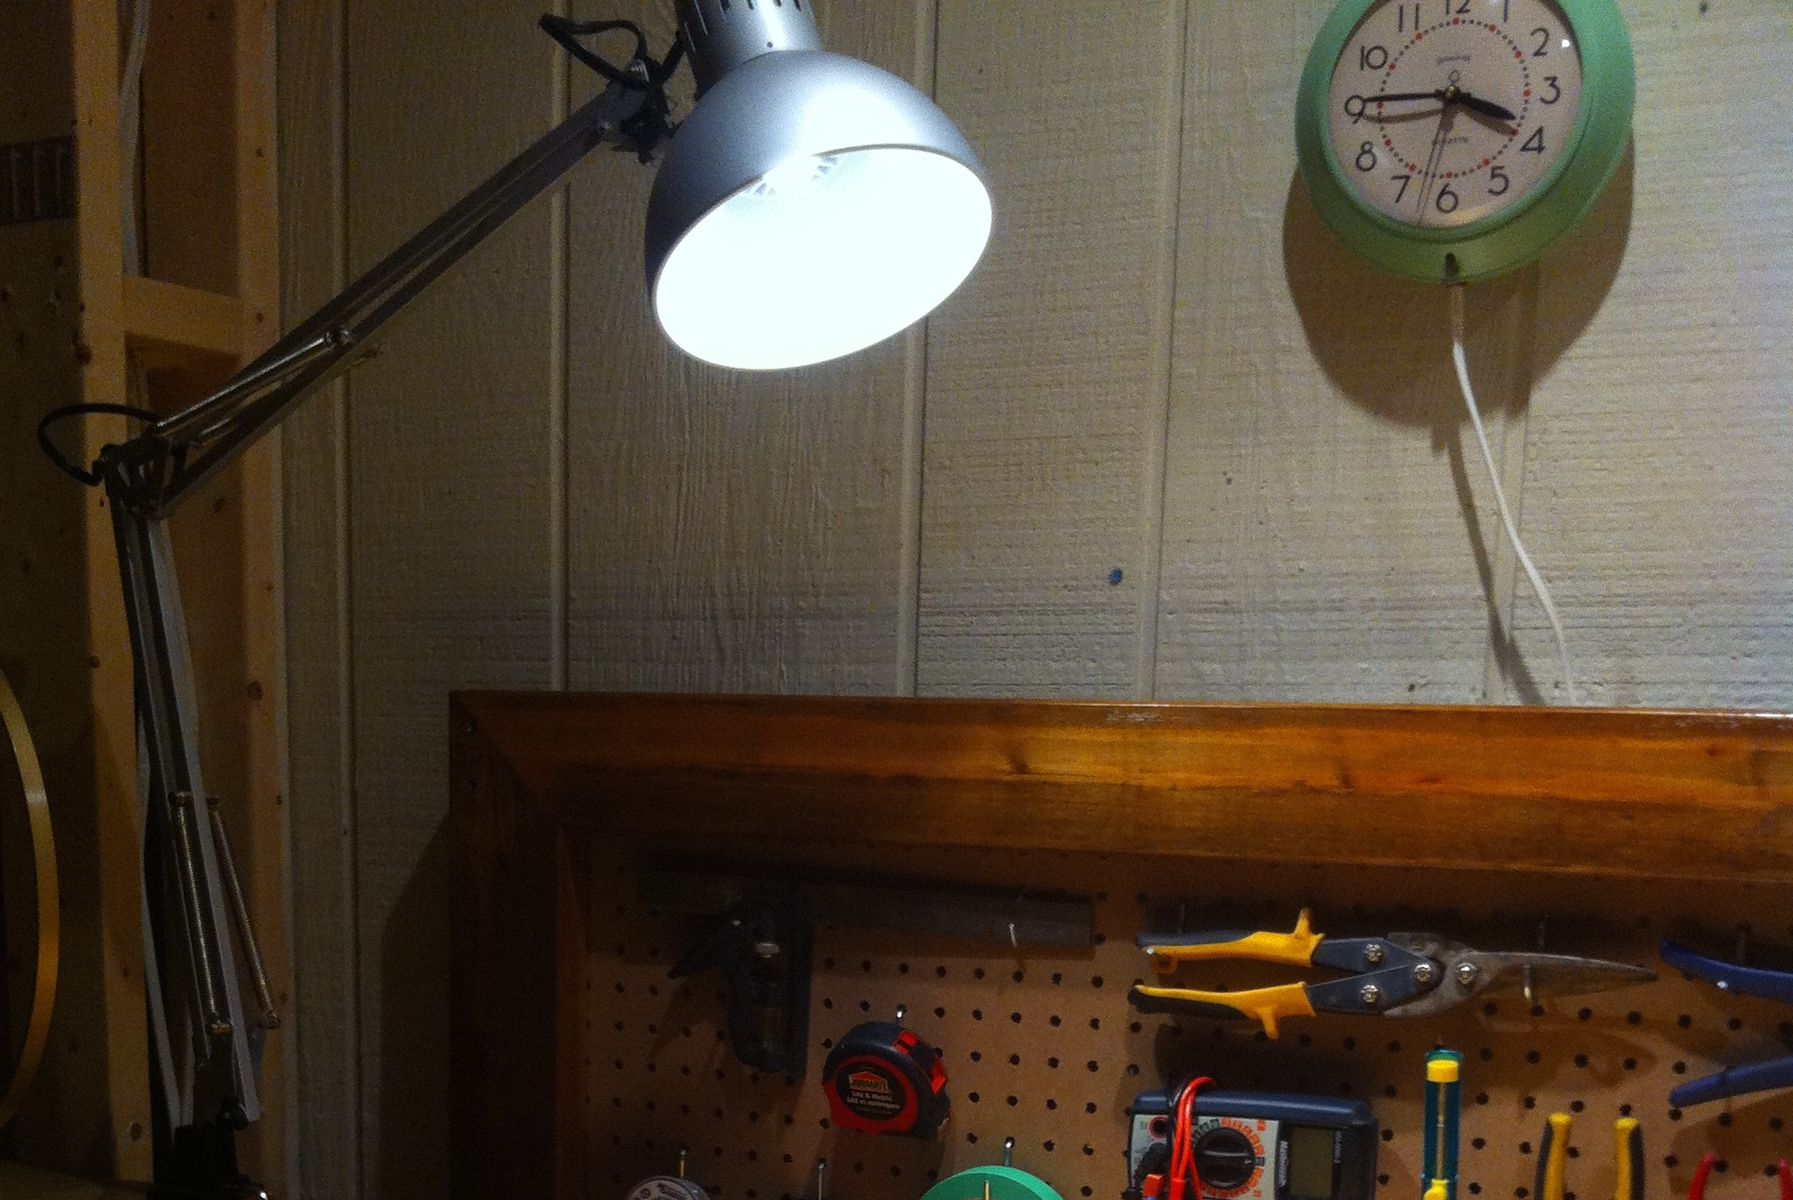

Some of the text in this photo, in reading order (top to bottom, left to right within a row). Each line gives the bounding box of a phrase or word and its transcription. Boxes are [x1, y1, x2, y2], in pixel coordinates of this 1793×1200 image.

[1397, 3, 1420, 32] 11
[1530, 27, 1551, 57] 2
[1360, 45, 1388, 71] 10
[1539, 75, 1561, 105] 3
[1344, 94, 1366, 125] 9
[1520, 126, 1545, 155] 4
[1355, 140, 1378, 172] 8
[1390, 174, 1411, 203] 7
[1487, 166, 1510, 196] 5
[1436, 183, 1459, 214] 6
